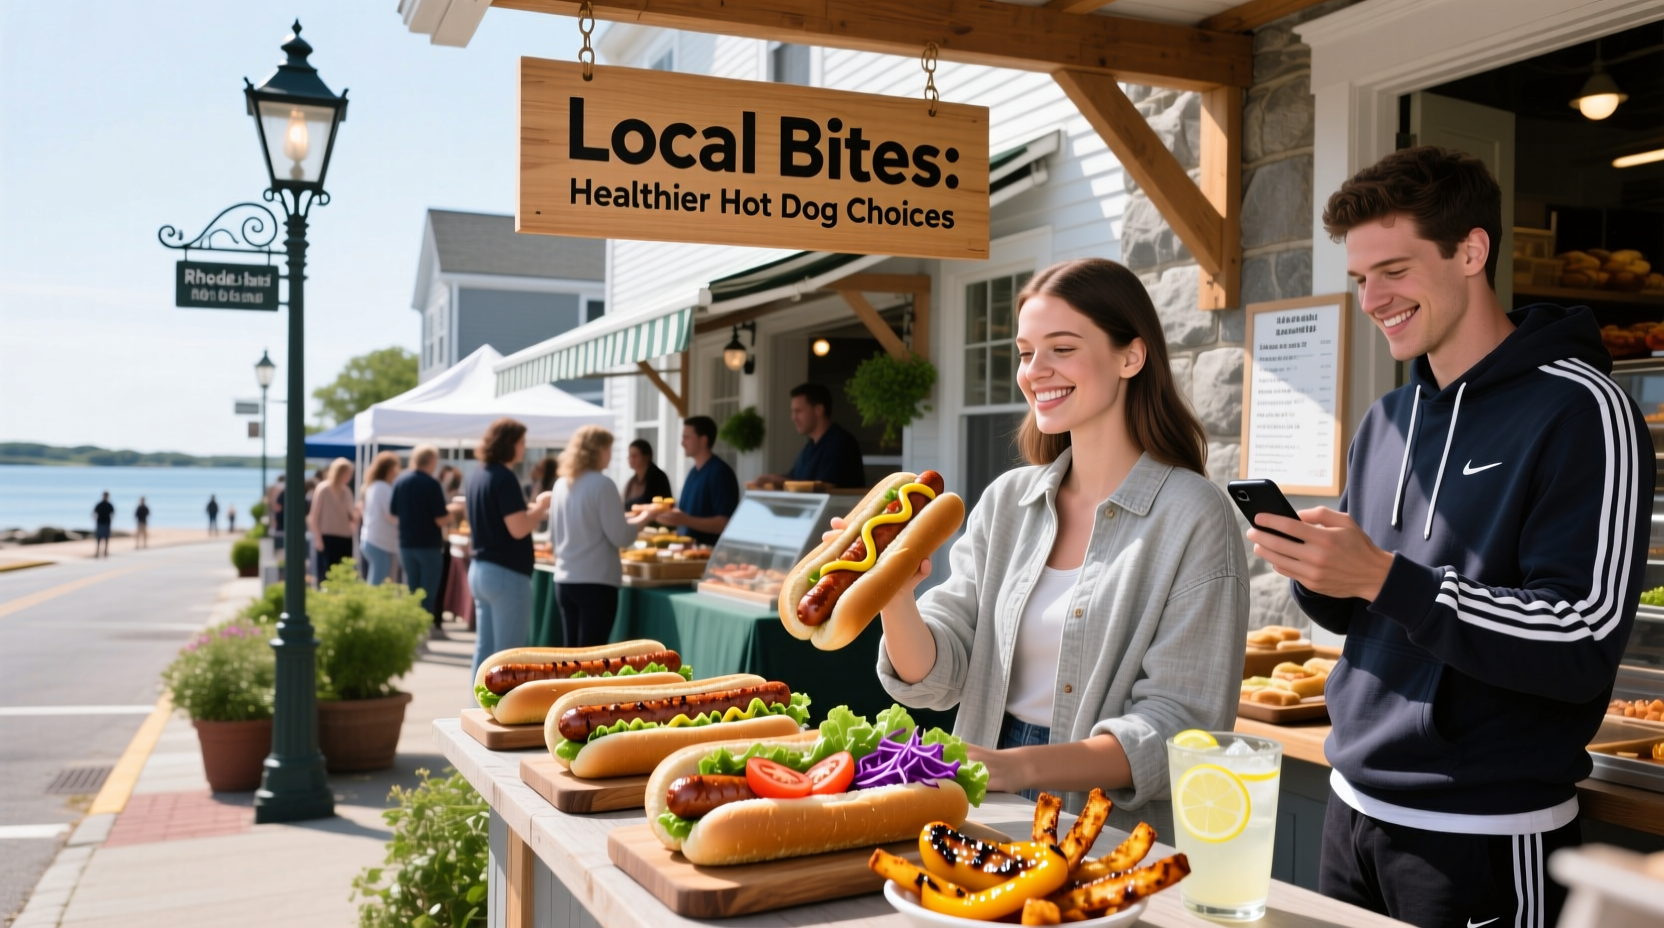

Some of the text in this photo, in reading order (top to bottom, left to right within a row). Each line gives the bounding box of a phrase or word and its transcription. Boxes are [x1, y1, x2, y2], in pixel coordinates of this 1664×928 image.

[569, 97, 960, 190] Local Bites:
[570, 178, 955, 230] Healthier Hot Dog Choices
